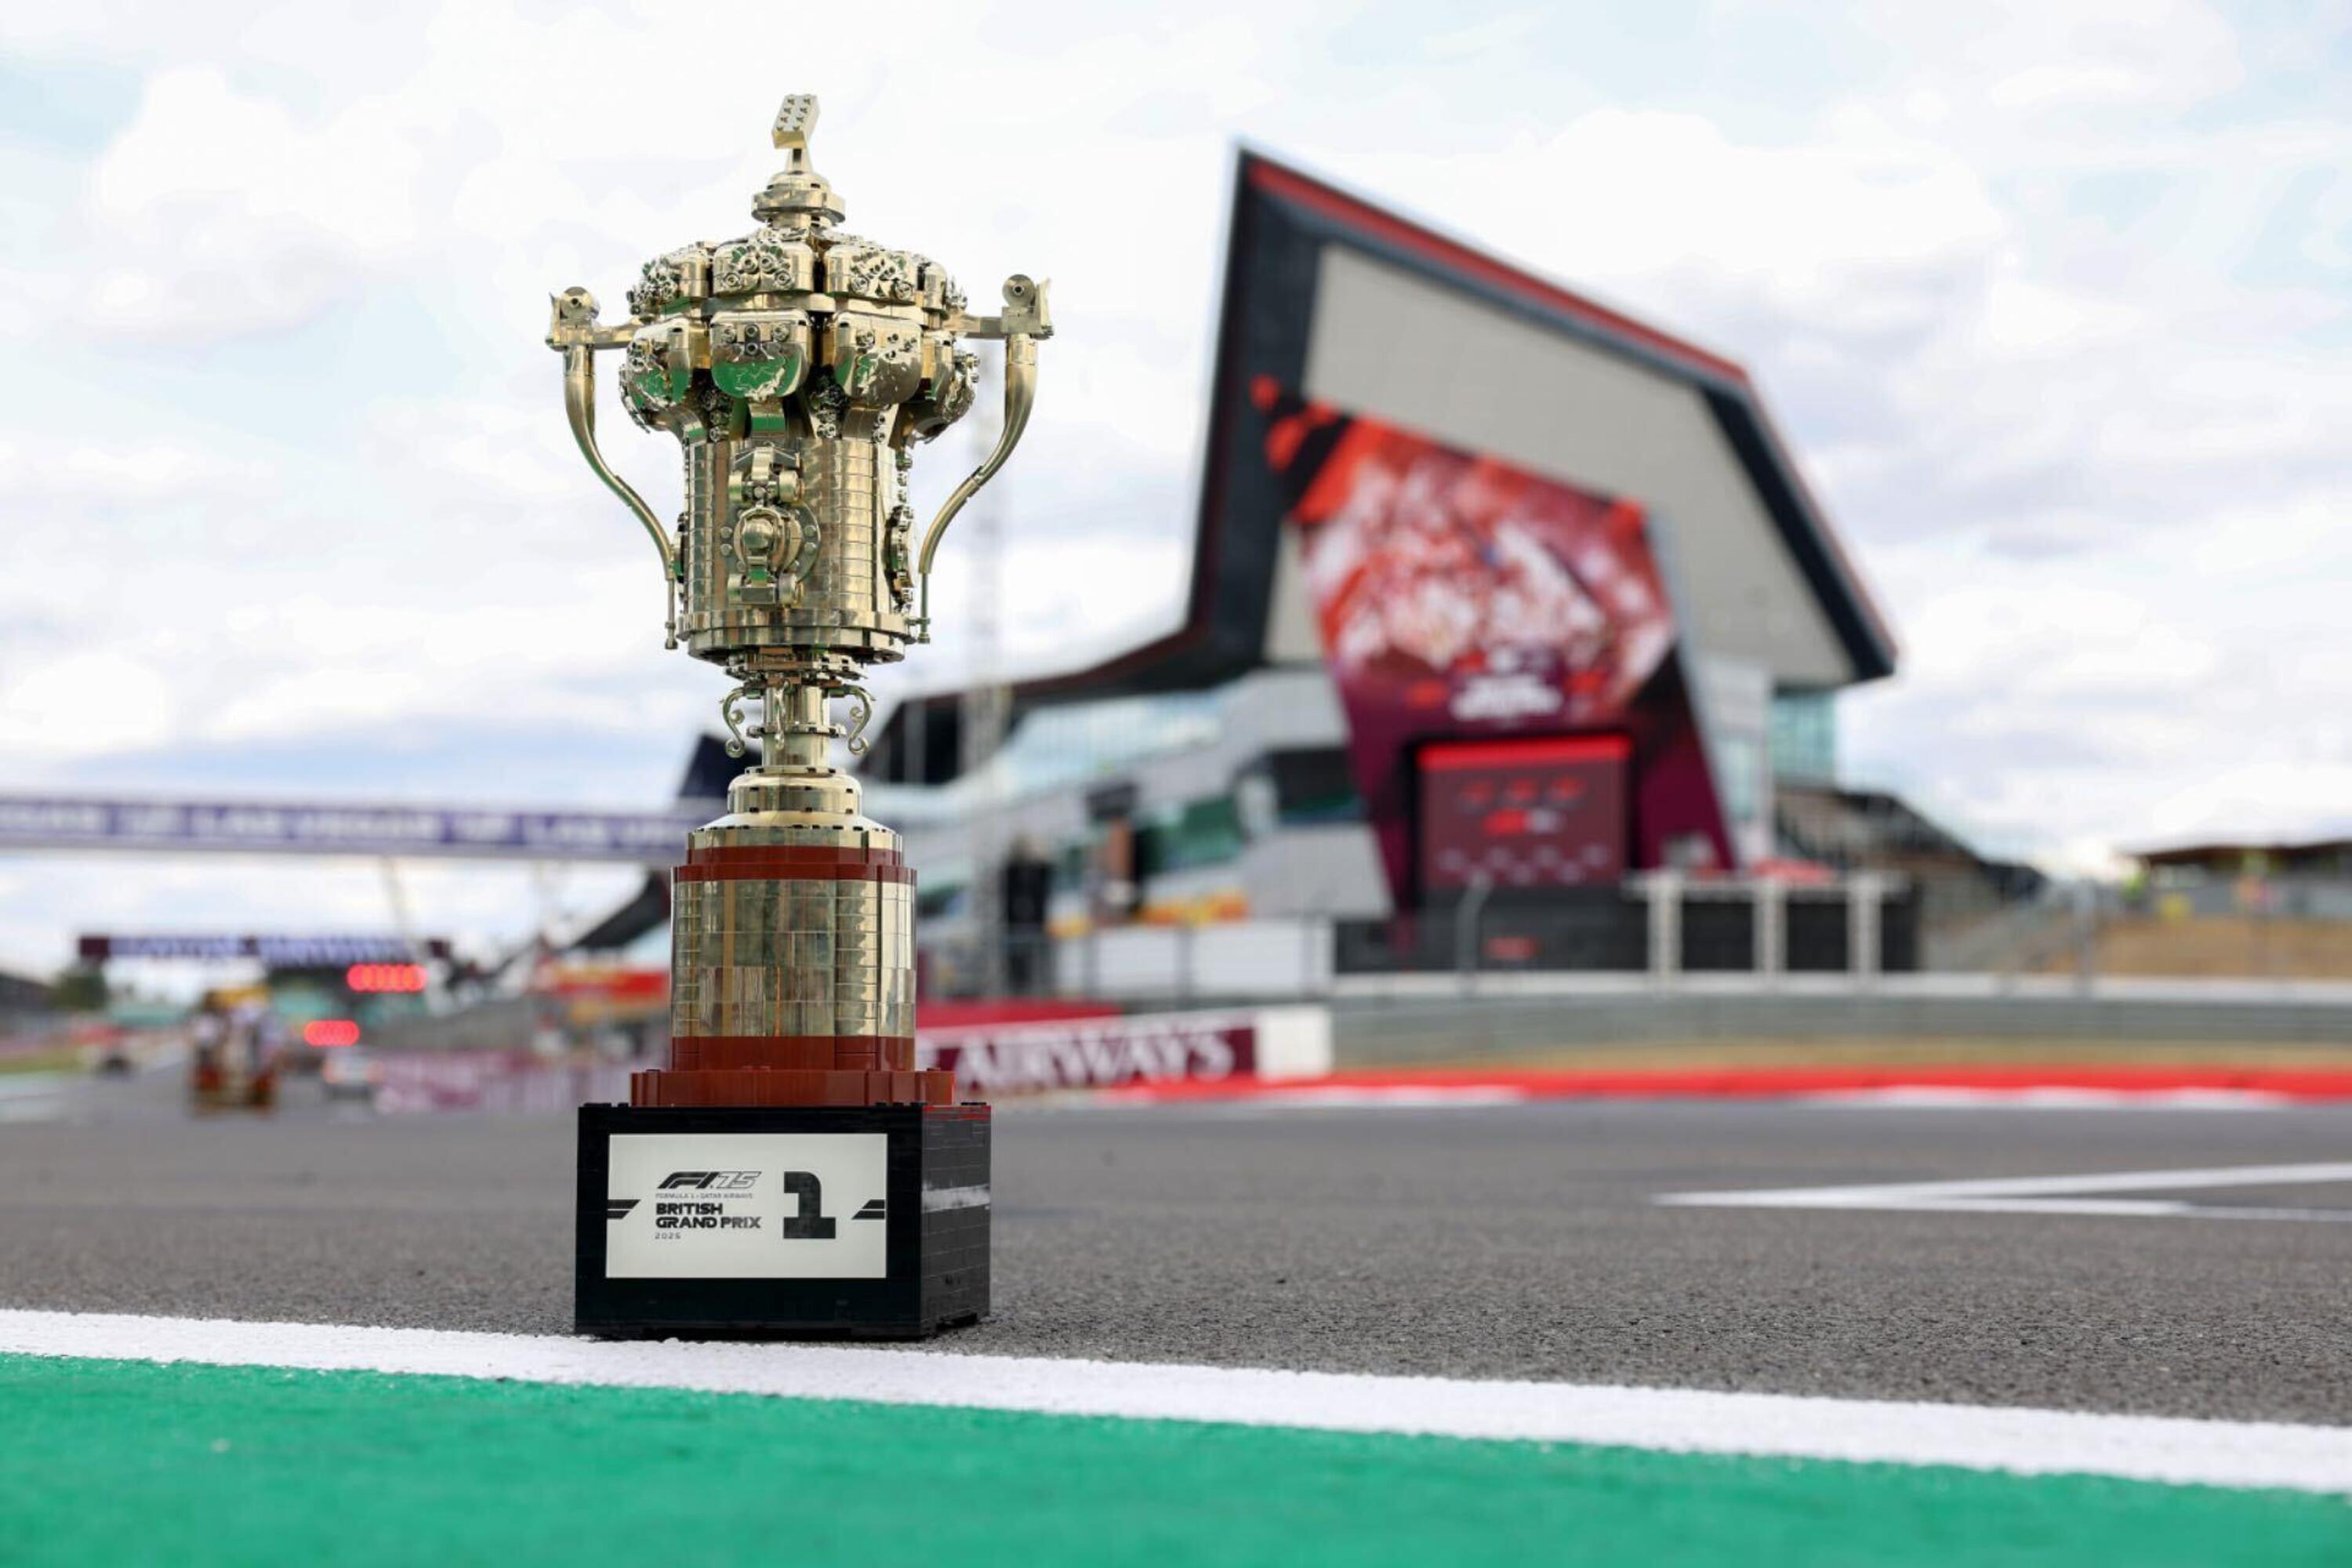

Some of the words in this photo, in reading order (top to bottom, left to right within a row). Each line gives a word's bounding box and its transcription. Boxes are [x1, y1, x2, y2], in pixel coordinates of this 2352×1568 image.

[955, 1031, 1236, 1091] AIRWAYS
[655, 1203, 723, 1215] BRITISH
[655, 1217, 717, 1229] GRAND
[720, 1217, 761, 1229] PRIX
[783, 1171, 836, 1239] 1
